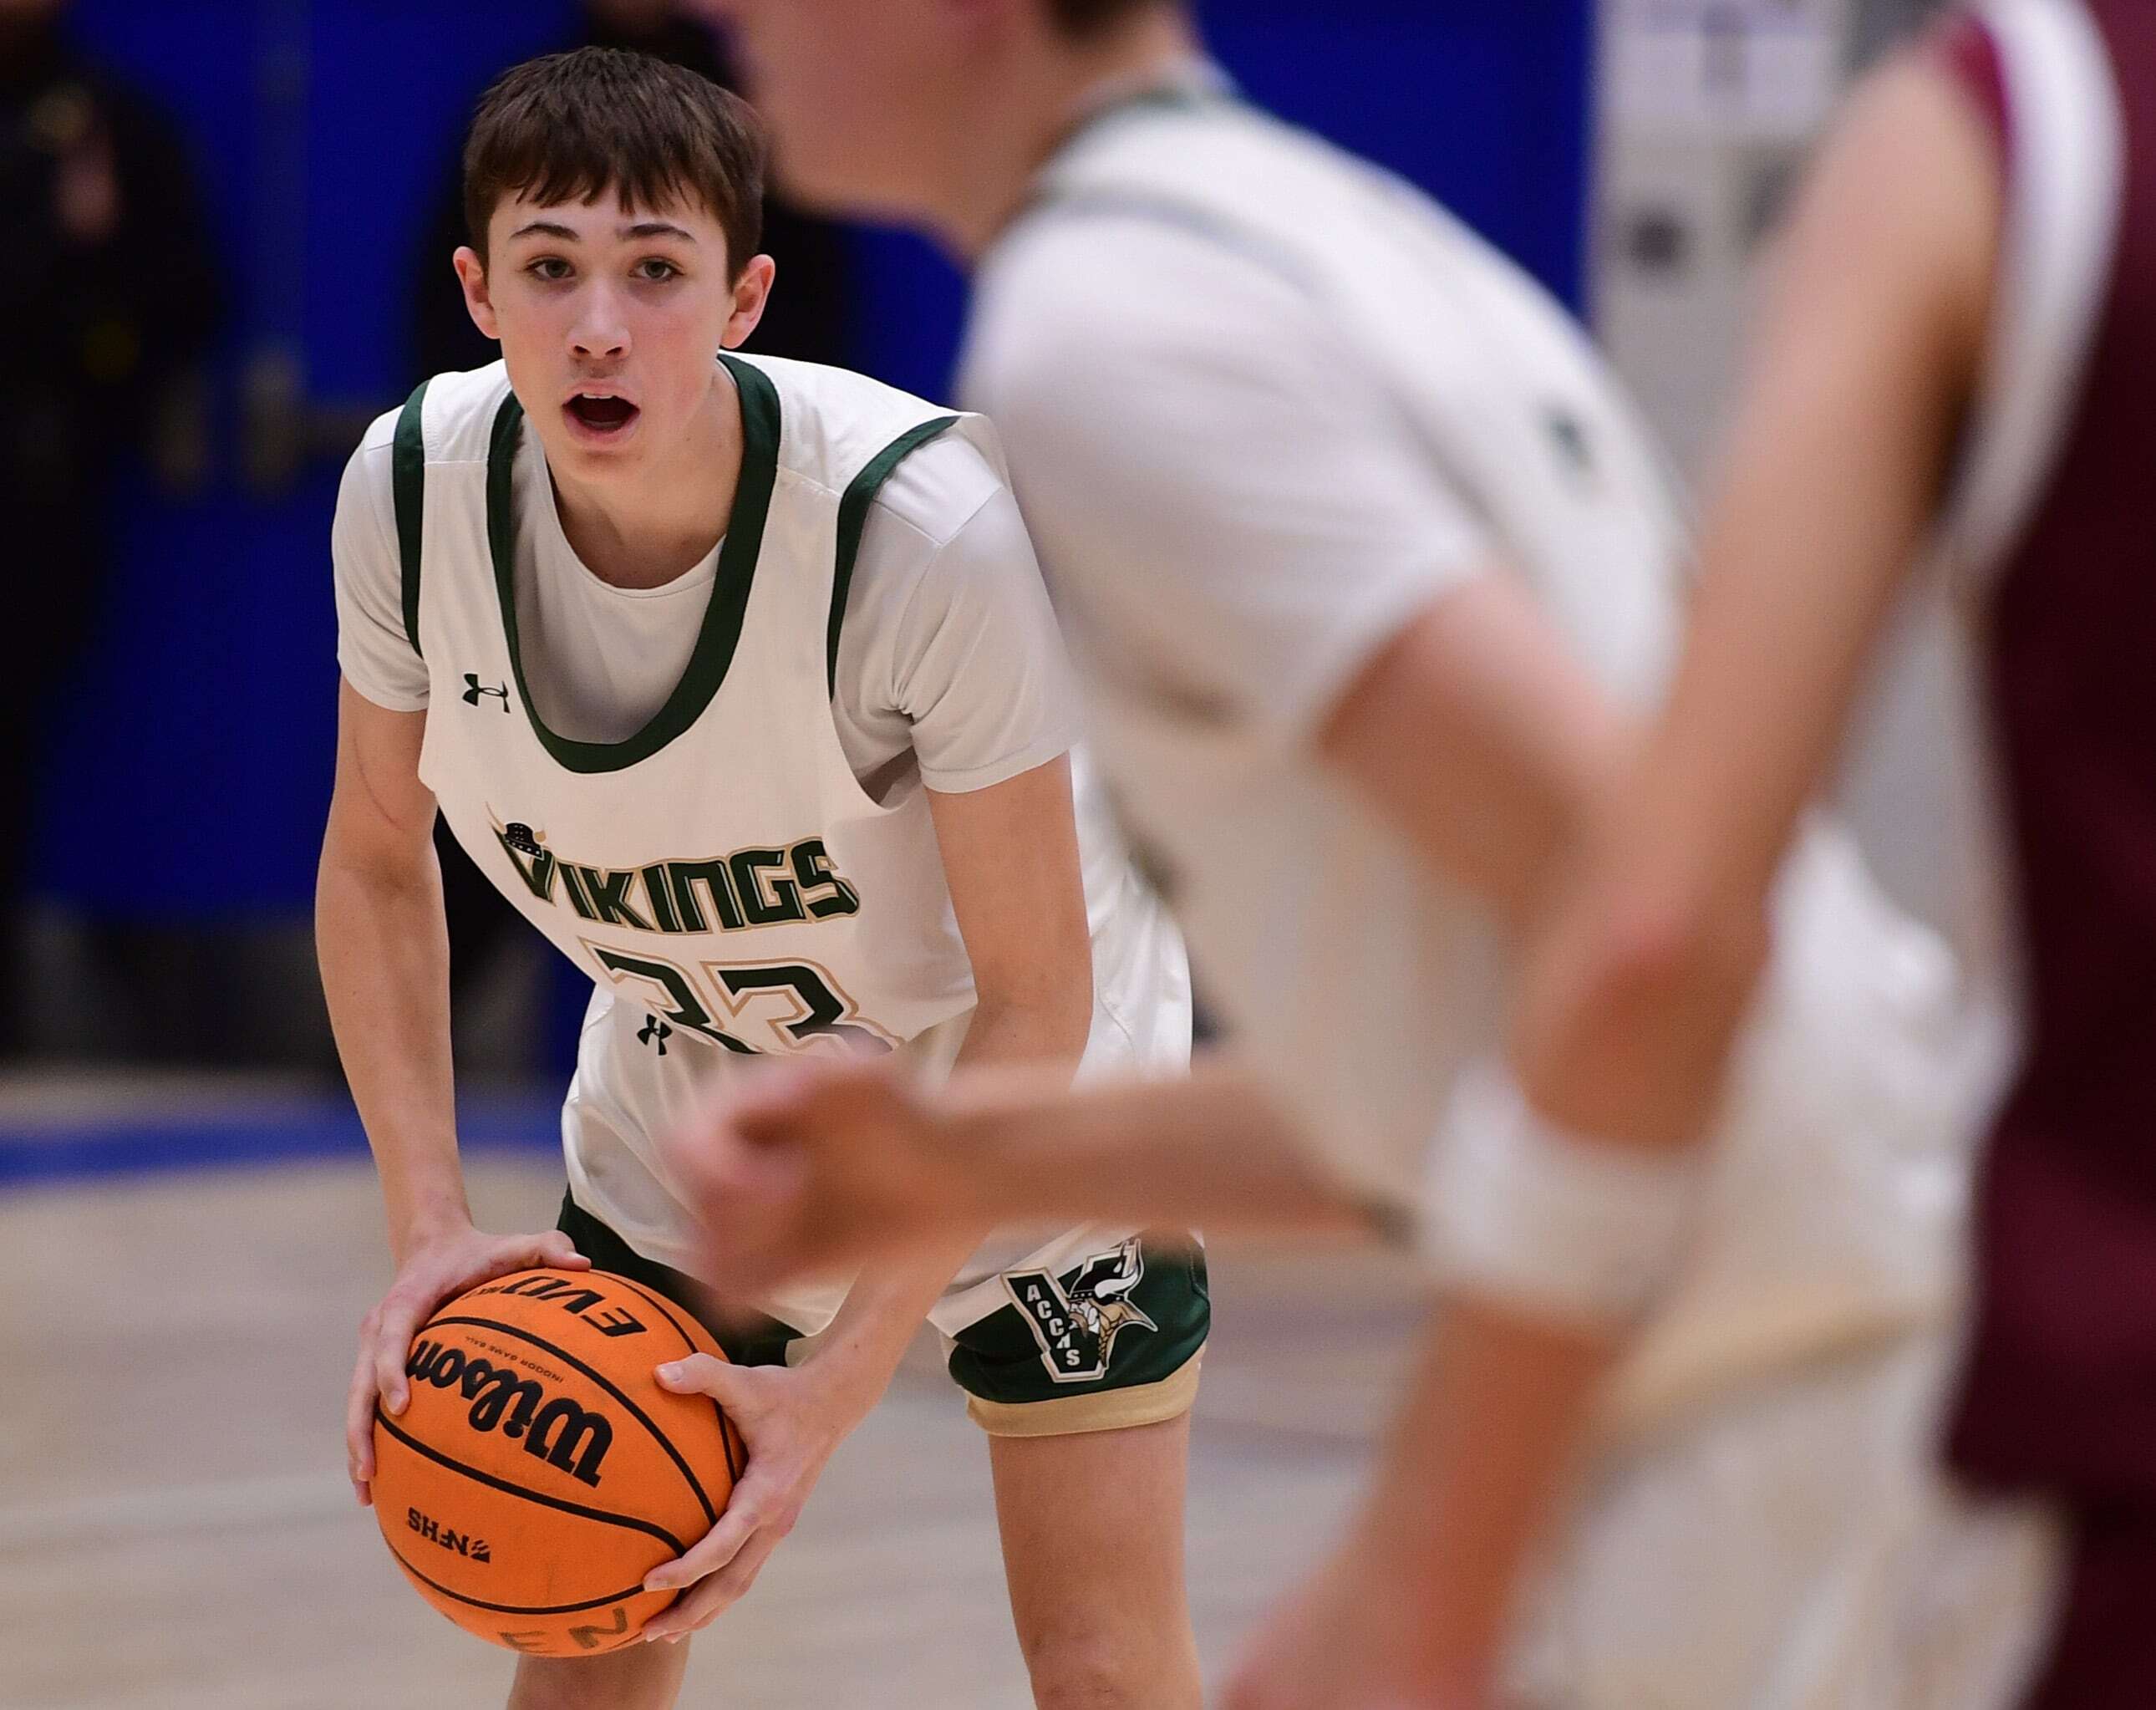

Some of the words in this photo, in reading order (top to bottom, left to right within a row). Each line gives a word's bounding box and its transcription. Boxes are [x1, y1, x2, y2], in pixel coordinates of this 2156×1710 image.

[491, 823, 861, 935] VIKINGS
[465, 1335, 486, 1348] BALL
[489, 1344, 518, 1361] GAME
[519, 1359, 564, 1383] INDOOR
[405, 1340, 613, 1489] Wilson
[408, 1507, 469, 1556] NFHS
[489, 1606, 628, 1653] EN
